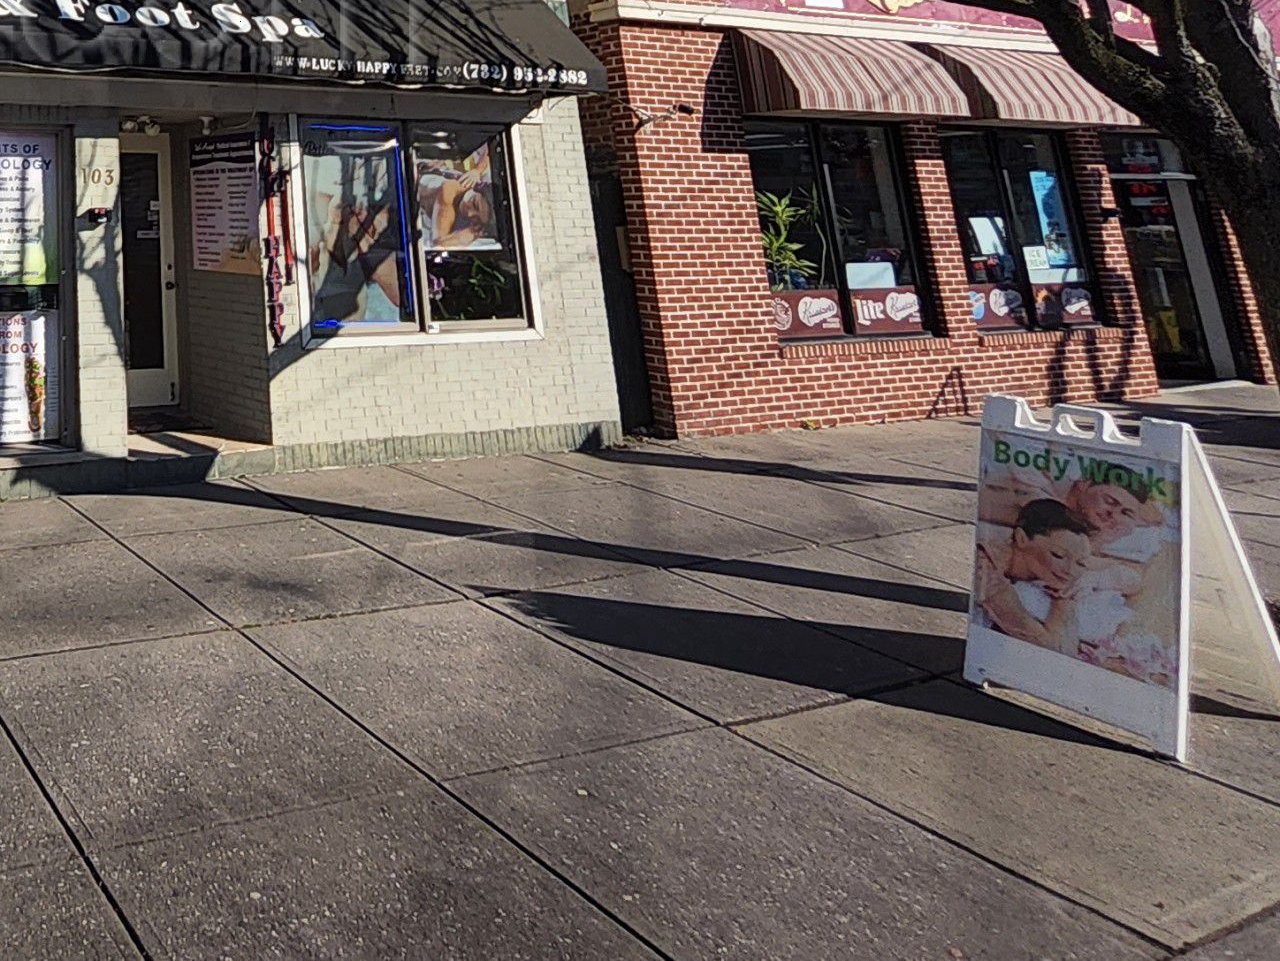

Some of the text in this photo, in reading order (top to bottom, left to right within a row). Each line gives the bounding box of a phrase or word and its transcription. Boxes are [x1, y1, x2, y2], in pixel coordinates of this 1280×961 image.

[210, 1, 325, 43] Spa
[23, 144, 39, 155] OF
[81, 167, 115, 186] 103
[854, 298, 886, 326] Lite
[993, 439, 1168, 498] Body Work
